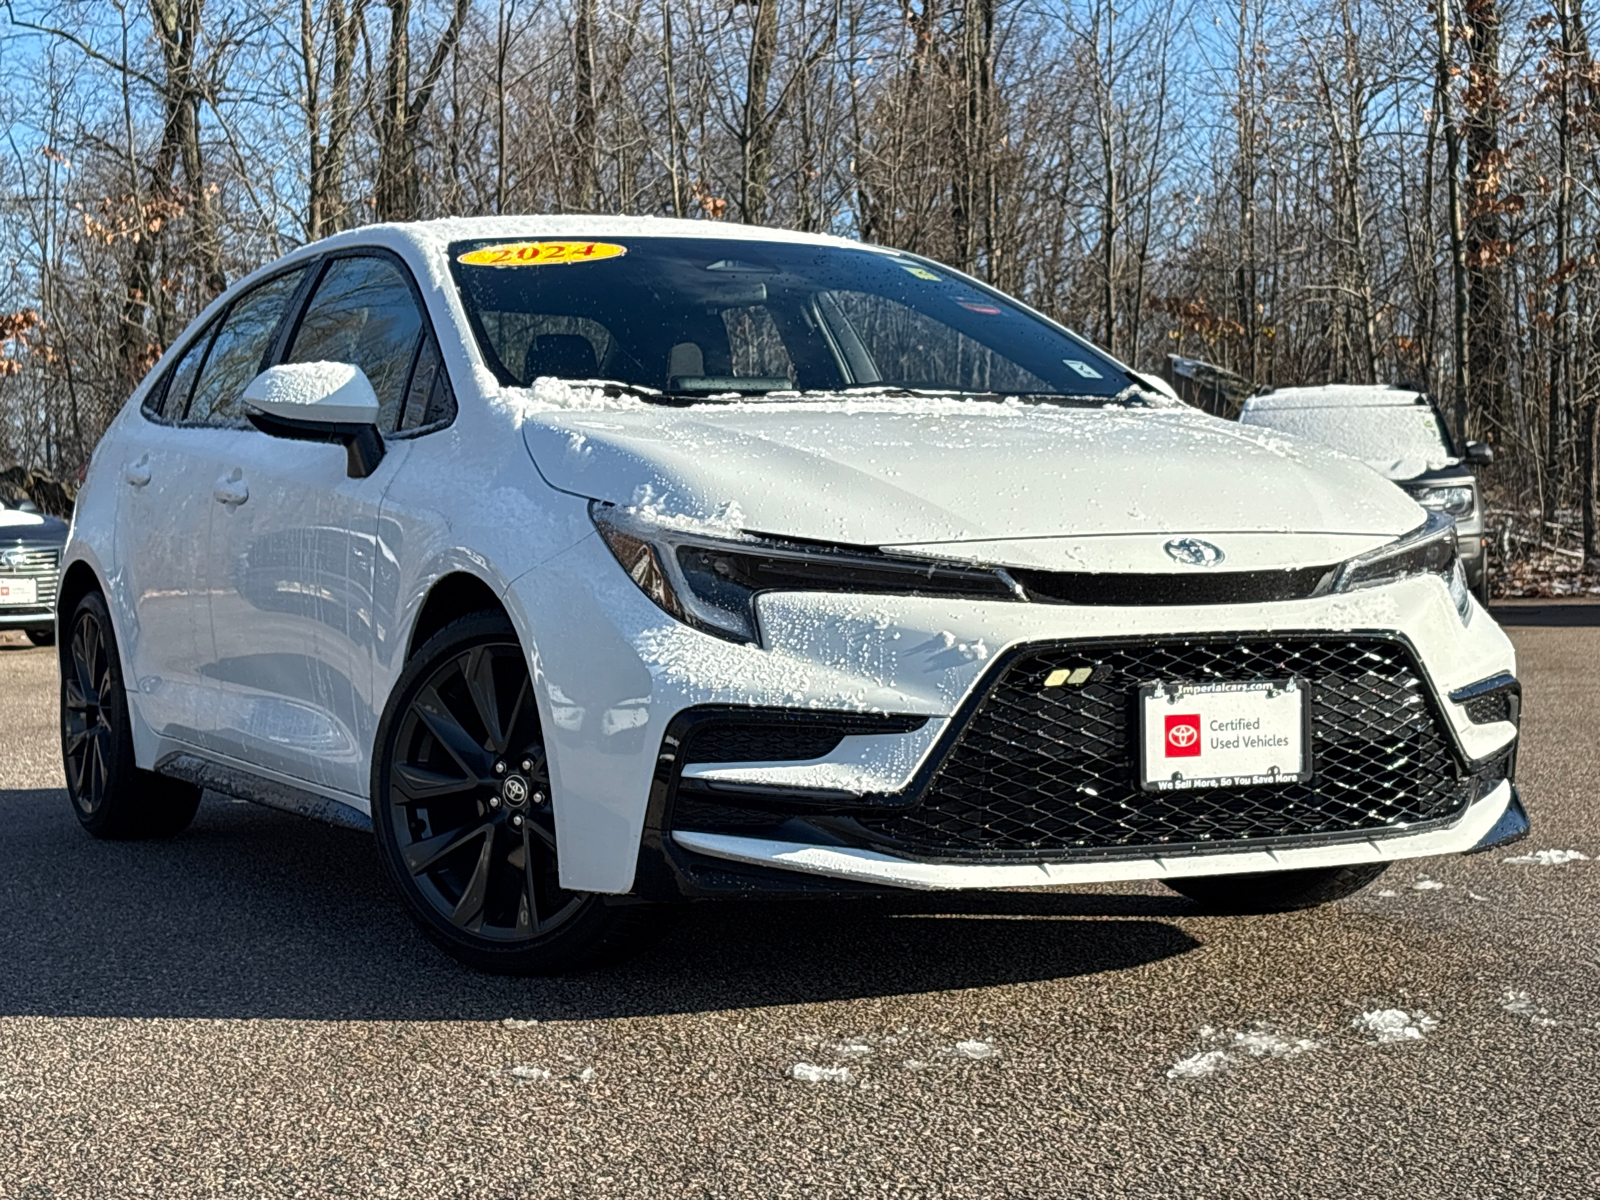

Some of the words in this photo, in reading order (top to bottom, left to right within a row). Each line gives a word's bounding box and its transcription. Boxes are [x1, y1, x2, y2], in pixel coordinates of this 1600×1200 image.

[490, 244, 597, 264] 2024
[1177, 682, 1274, 695] Imperialcars.com
[1209, 717, 1260, 732] Certified
[1210, 734, 1240, 749] Used
[1242, 733, 1289, 748] Vehicles
[1158, 781, 1172, 791] We
[1174, 780, 1192, 790] Sell
[1193, 779, 1219, 789] More,
[1220, 777, 1232, 787] So
[1233, 776, 1251, 786] You
[1252, 775, 1274, 784] Save
[1275, 774, 1298, 783] More
